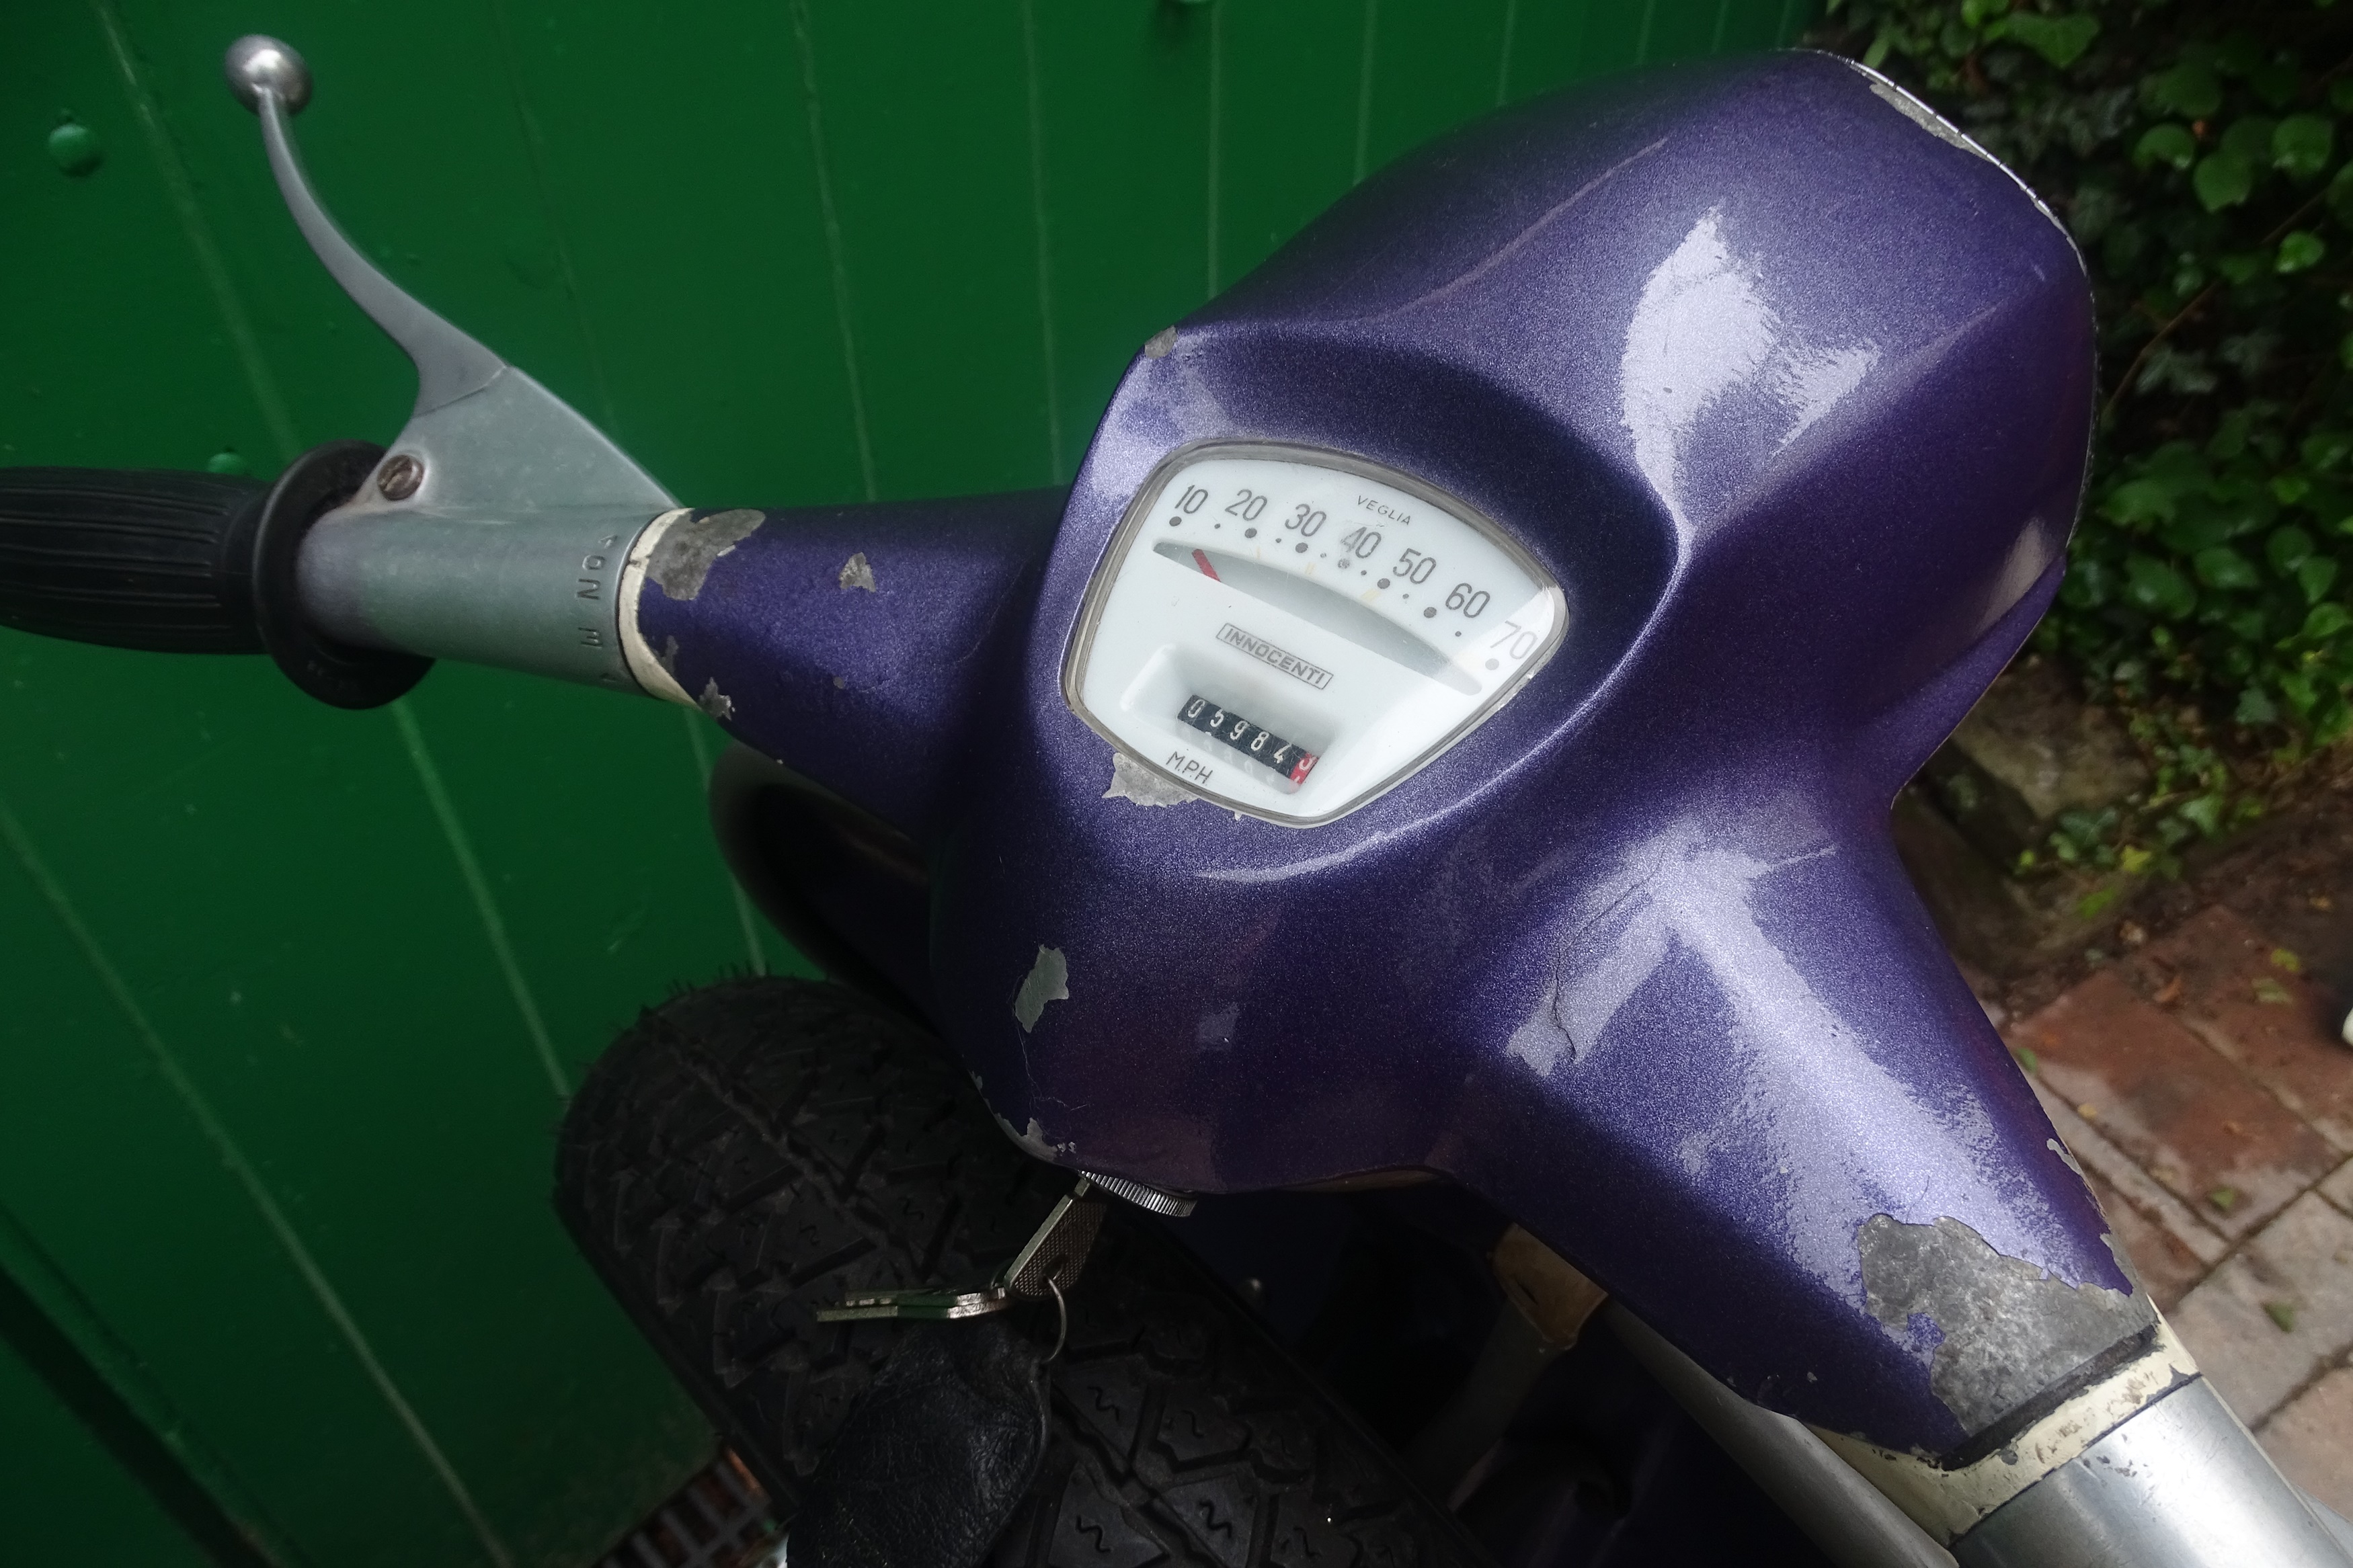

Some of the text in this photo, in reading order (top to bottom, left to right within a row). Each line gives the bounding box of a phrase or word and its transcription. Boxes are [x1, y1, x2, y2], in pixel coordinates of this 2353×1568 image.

[1357, 495, 1412, 526] VEGLIA
[1174, 485, 1538, 659] 10 20 30 40 50 60 70
[1224, 628, 1326, 684] INNOCENTI
